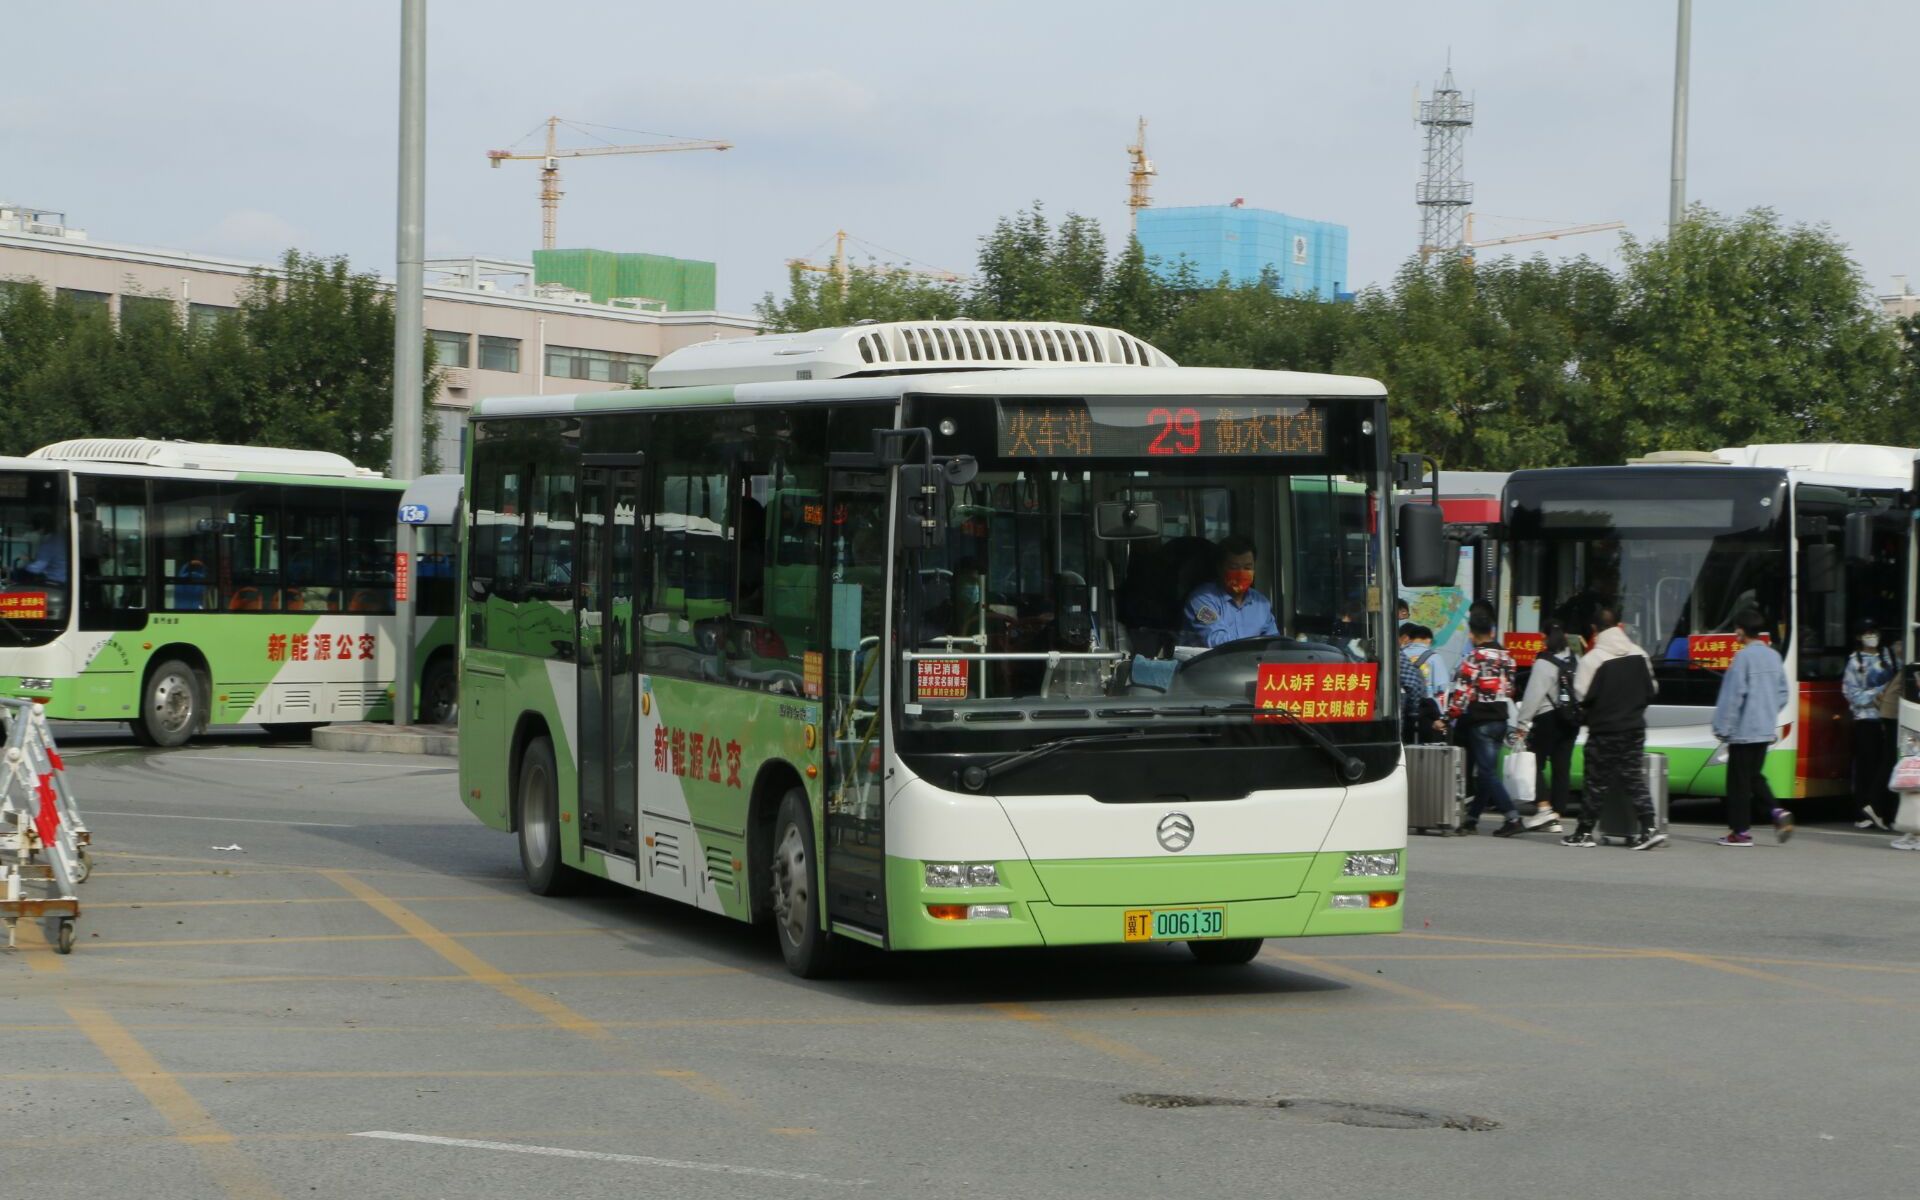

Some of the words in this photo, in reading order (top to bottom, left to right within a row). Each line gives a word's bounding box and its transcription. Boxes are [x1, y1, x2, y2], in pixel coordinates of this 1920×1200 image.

[1008, 409, 1092, 455] 火车站
[1148, 408, 1201, 455] 29
[1216, 408, 1325, 453] 衡水北站
[267, 633, 375, 661] 新能源公交
[918, 663, 960, 675] 车辆已消毒
[1264, 674, 1315, 691] 人人动手
[1322, 673, 1371, 691] 全民参与
[655, 723, 742, 790] 新能源公交
[1127, 914, 1149, 937] 冀T
[1157, 911, 1222, 935] 00613D
